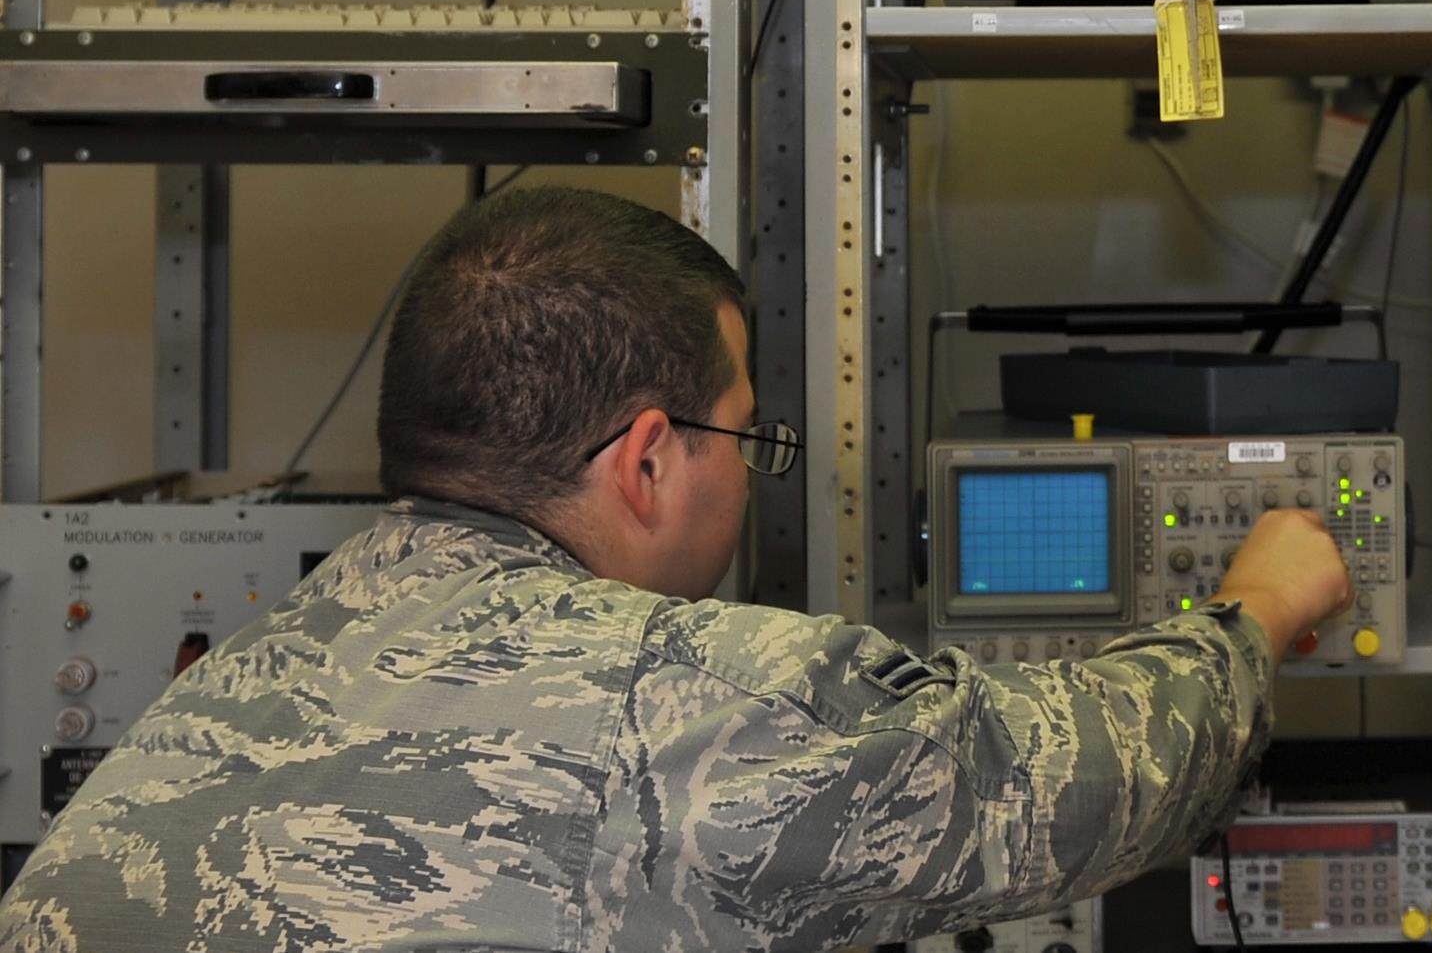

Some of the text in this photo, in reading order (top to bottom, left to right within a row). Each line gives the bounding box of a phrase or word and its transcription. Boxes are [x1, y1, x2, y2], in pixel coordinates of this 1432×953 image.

[65, 512, 89, 525] 1A2
[64, 531, 264, 544] MODULATION GENERATOR
